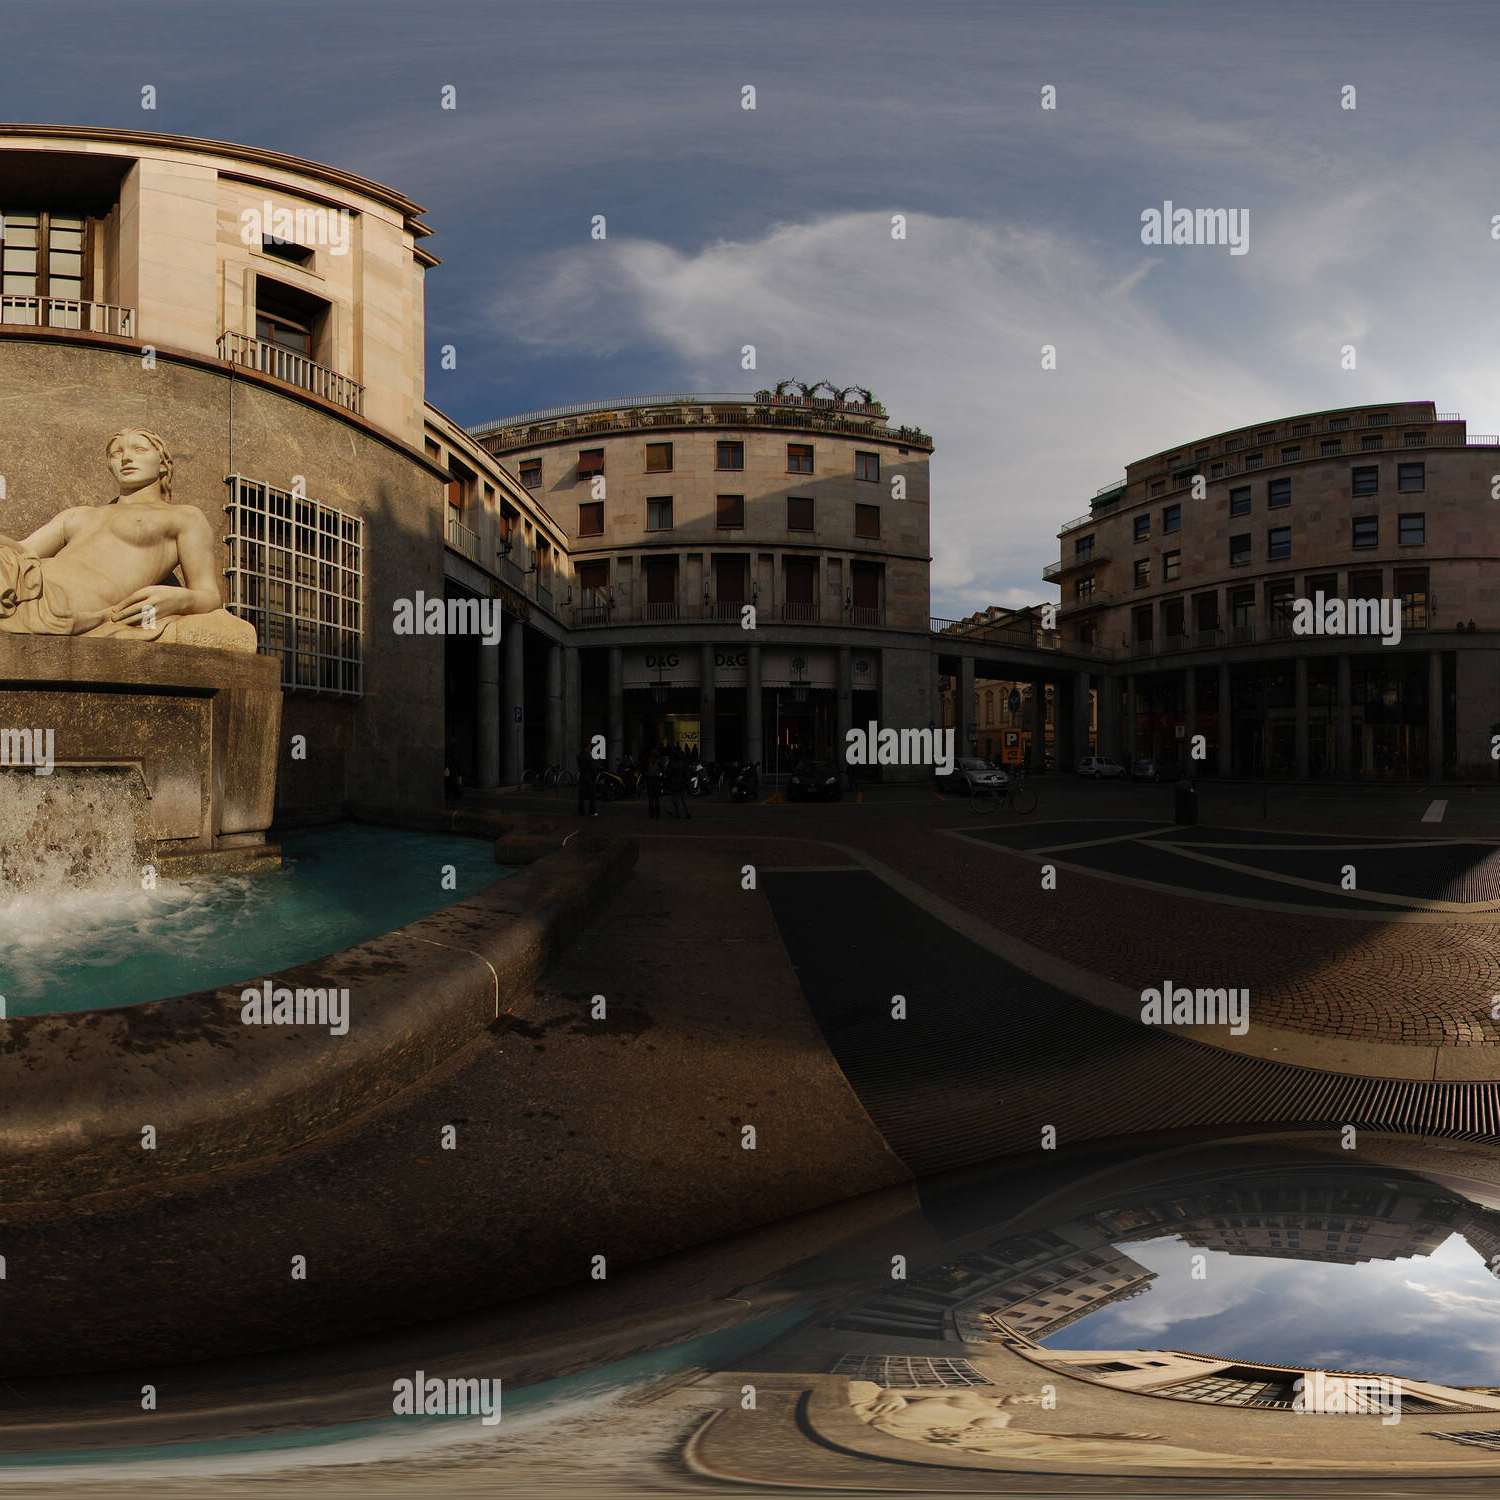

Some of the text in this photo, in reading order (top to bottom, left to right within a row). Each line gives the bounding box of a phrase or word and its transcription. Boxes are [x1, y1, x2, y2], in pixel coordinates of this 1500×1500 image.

[646, 654, 680, 668] D&G
[715, 653, 748, 667] D&G
[1006, 732, 1017, 746] P
